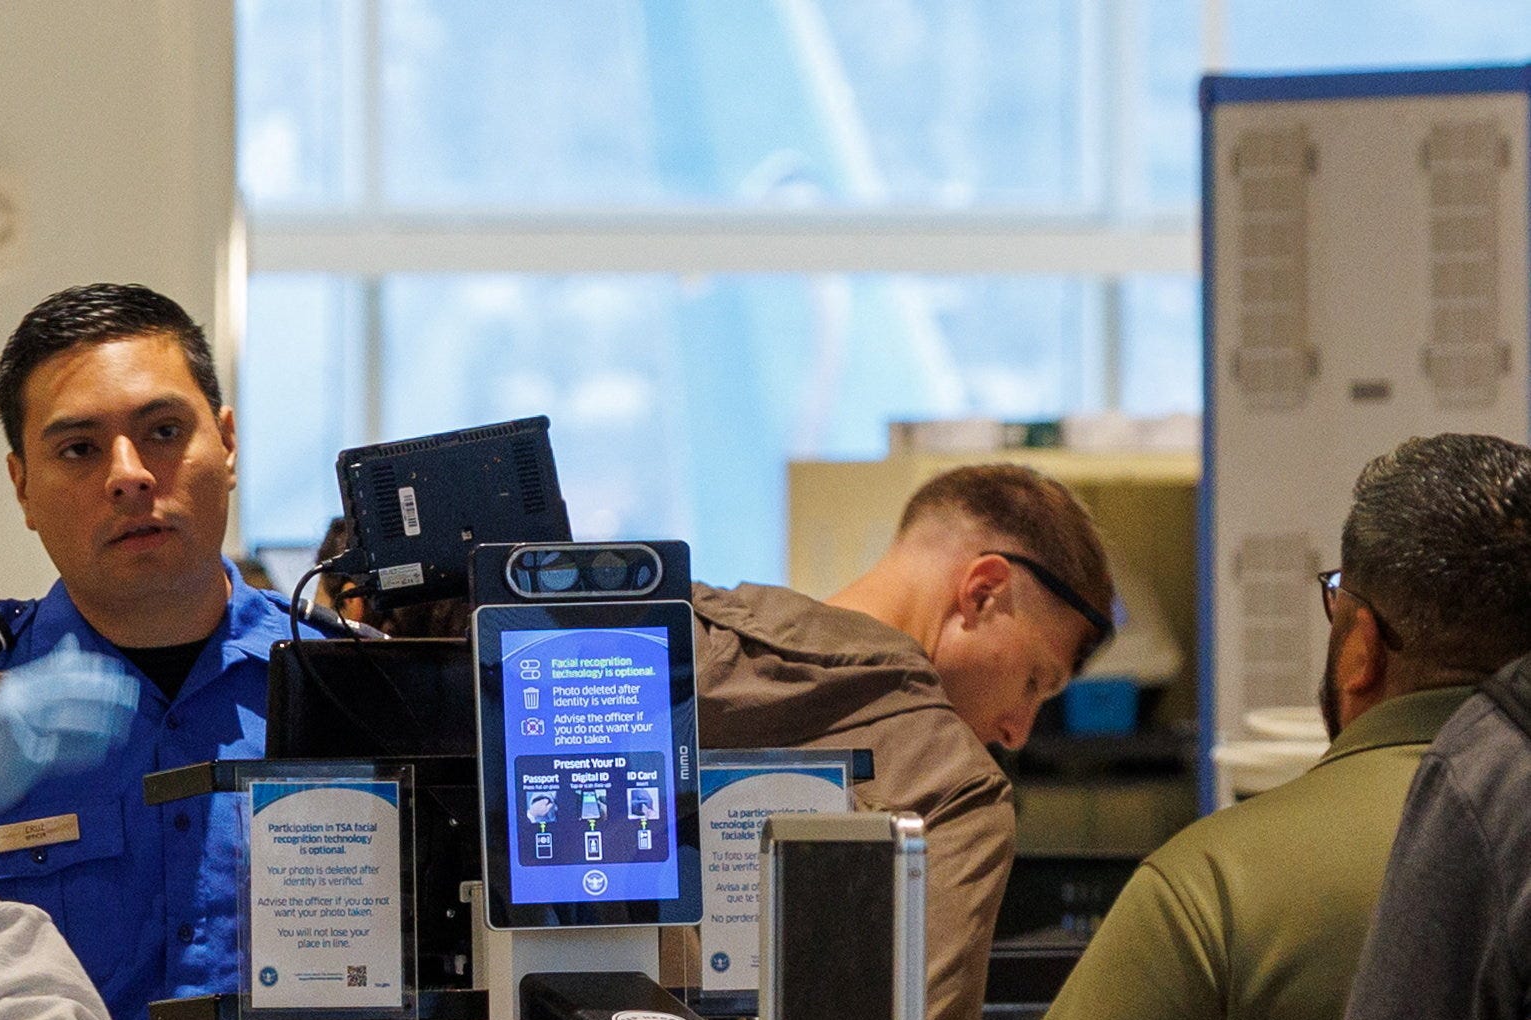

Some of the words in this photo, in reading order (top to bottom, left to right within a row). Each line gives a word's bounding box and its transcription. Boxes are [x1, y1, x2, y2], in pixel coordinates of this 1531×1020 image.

[551, 659, 579, 668] Facial
[580, 657, 633, 668] recognition
[552, 668, 603, 679] technology
[605, 668, 614, 677] is
[615, 667, 656, 678] optional.
[552, 687, 580, 696] Photo
[582, 685, 617, 695] deleted
[618, 684, 641, 694] after
[553, 696, 590, 707] identity
[591, 696, 599, 705] is
[600, 694, 640, 705] verified.
[554, 714, 586, 724] Advise
[587, 713, 604, 722] the
[604, 712, 635, 722] officer
[636, 711, 644, 721] if
[554, 726, 572, 736] you
[574, 723, 587, 733] do
[588, 724, 603, 733] not
[605, 723, 630, 733] want
[631, 724, 654, 734] your
[554, 736, 582, 746] photo
[584, 735, 612, 744] taken.
[554, 759, 590, 769] Present
[591, 758, 614, 768] Your
[614, 758, 626, 767] ID
[679, 745, 689, 780] mimo
[523, 774, 559, 784] Passport
[571, 772, 598, 783] Digital
[599, 772, 609, 781] ID
[627, 771, 637, 780] ID
[638, 771, 657, 780] Card
[728, 809, 739, 818] La
[25, 823, 45, 834] CRUZ
[268, 823, 323, 834] Participation
[325, 823, 334, 832] in
[336, 823, 352, 832] TSA
[354, 822, 378, 832] facial
[273, 835, 322, 845] recognition
[324, 834, 373, 845] technology
[299, 845, 307, 854] is
[308, 844, 347, 855] optional.
[725, 851, 743, 860] foto
[267, 865, 287, 875] Your
[289, 865, 315, 877] photo
[316, 865, 323, 874] is
[325, 865, 358, 875] deleted
[359, 865, 380, 875] after
[709, 863, 720, 872] de
[721, 862, 730, 871] la
[283, 877, 317, 888] identity
[319, 877, 326, 886] is
[328, 876, 364, 886] verified.
[716, 882, 740, 891] Avisa
[741, 882, 750, 891] al
[258, 897, 287, 906] Advise
[289, 897, 304, 906] the
[304, 896, 334, 906] officer
[335, 896, 343, 906] if
[343, 898, 361, 908] you
[362, 897, 374, 906] do
[375, 897, 390, 906] not
[726, 894, 743, 903] que
[745, 893, 755, 902] te
[274, 908, 296, 917] want
[298, 908, 319, 919] your
[320, 907, 346, 919] photo
[348, 907, 373, 917] taken.
[711, 914, 725, 923] No
[277, 928, 295, 937] You
[296, 927, 312, 937] will
[313, 928, 329, 937] not
[330, 927, 349, 937] lose
[350, 928, 371, 939] your
[297, 938, 320, 949] place
[322, 939, 331, 948] in
[332, 938, 350, 948] line.
